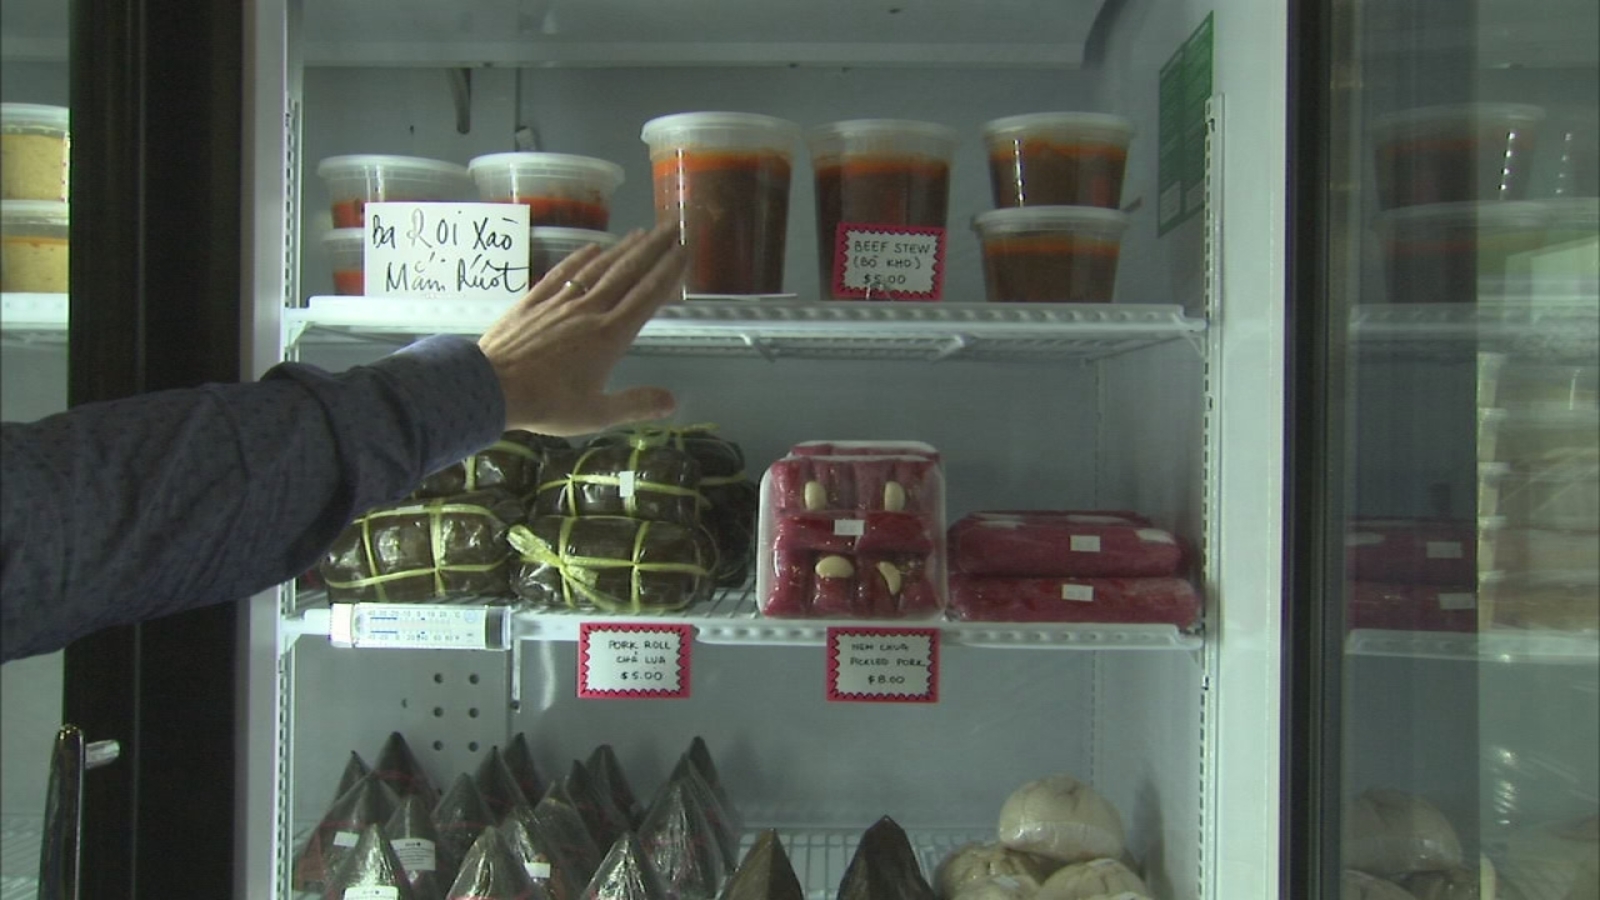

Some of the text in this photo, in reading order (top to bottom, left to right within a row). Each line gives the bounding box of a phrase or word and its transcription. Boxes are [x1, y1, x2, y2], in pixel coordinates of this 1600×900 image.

[373, 214, 396, 249] Ba
[854, 240, 931, 254] BEEF STEW
[608, 640, 671, 650] PORK ROLL
[850, 657, 926, 668] PICKLED PORK
